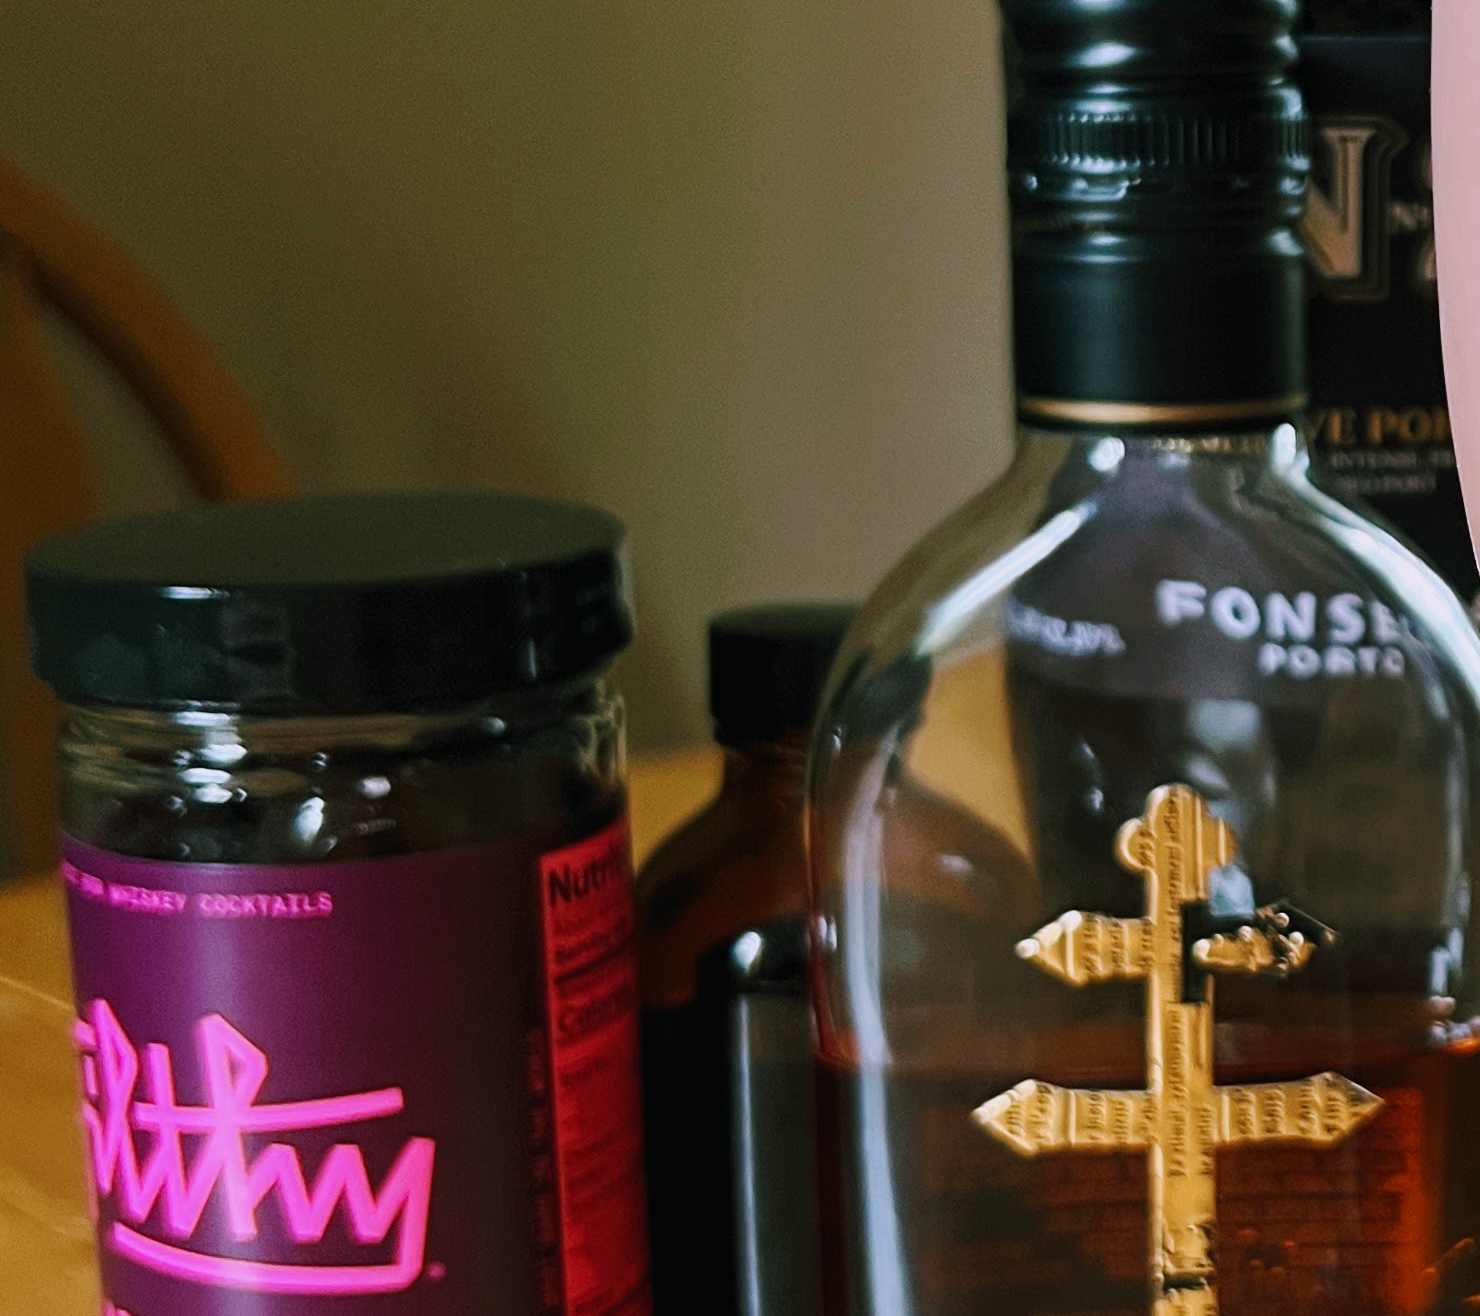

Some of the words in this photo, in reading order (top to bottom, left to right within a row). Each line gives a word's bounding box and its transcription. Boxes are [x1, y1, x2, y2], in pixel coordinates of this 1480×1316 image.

[1155, 579, 1403, 645] FONSE
[1258, 644, 1405, 679] PORTO
[197, 891, 333, 919] COCKTAILS
